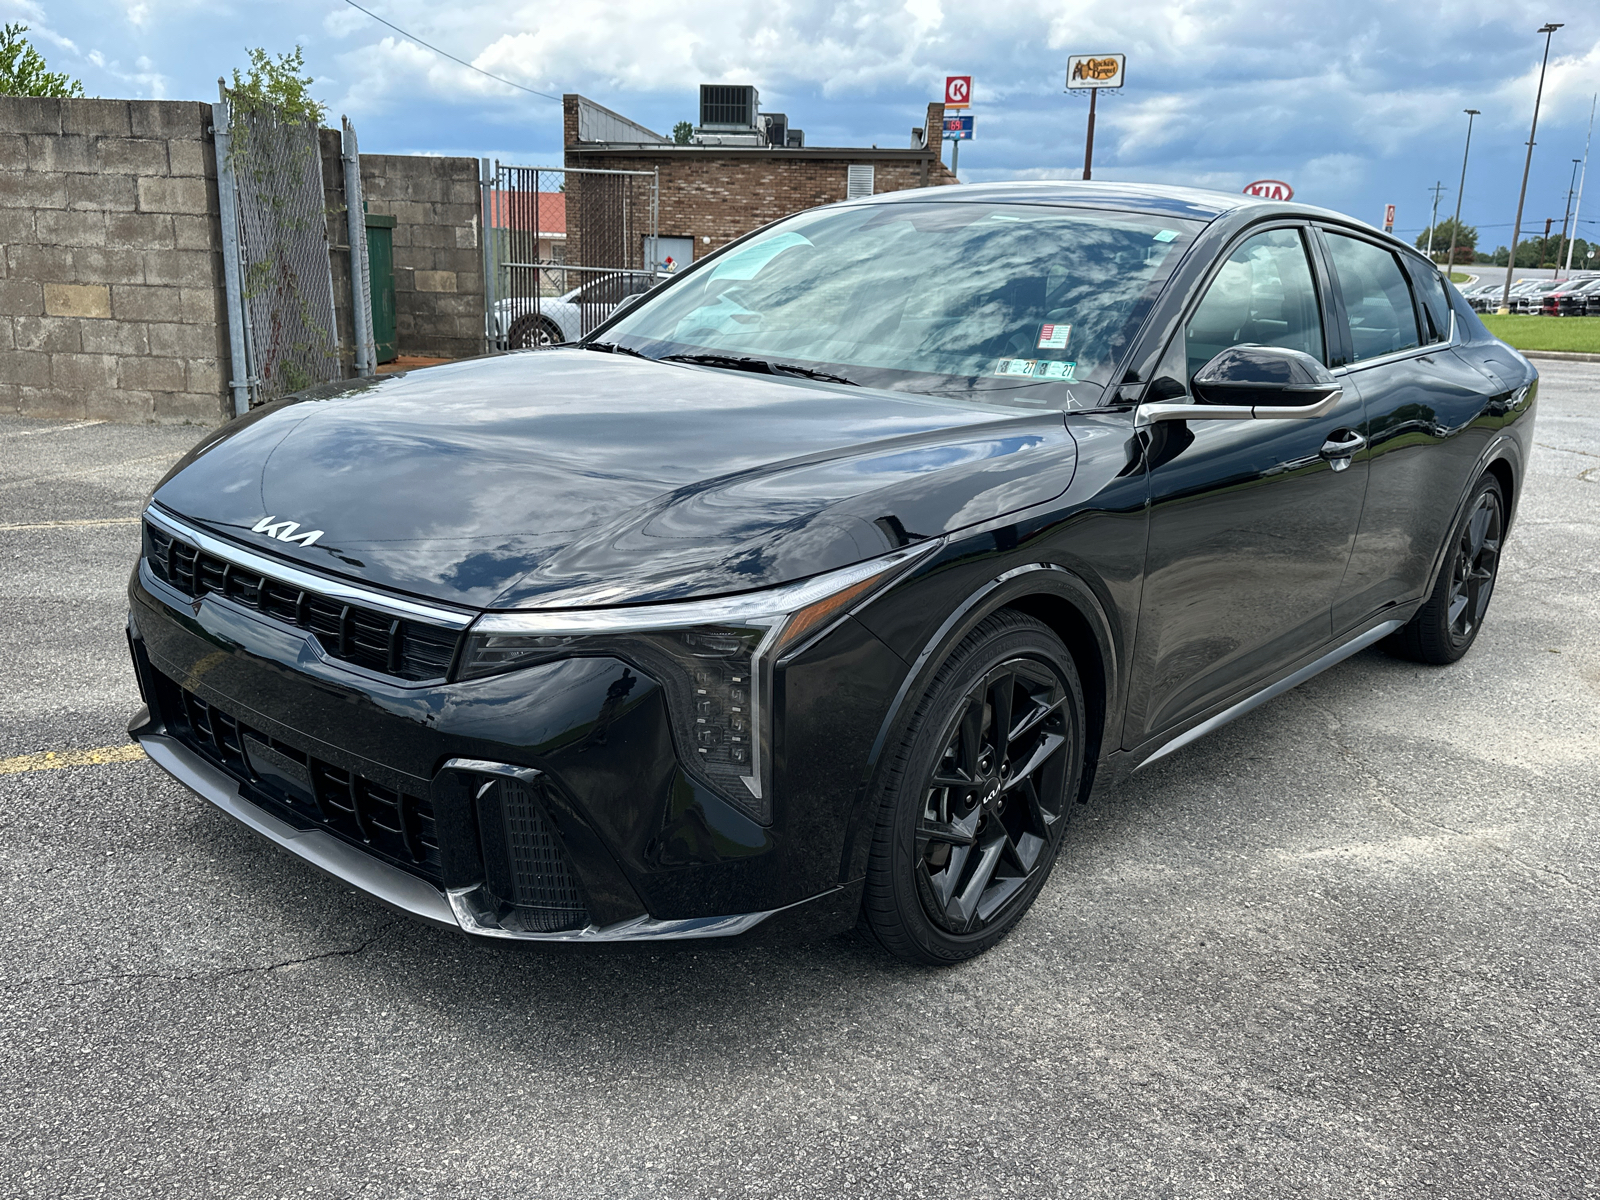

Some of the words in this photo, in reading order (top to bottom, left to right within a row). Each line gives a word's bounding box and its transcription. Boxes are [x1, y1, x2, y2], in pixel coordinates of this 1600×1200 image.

[953, 83, 965, 98] K
[1251, 186, 1283, 201] KIA
[1023, 362, 1034, 374] 27
[1062, 365, 1073, 377] 27
[251, 515, 325, 548] KIA
[983, 783, 1000, 804] KIA
